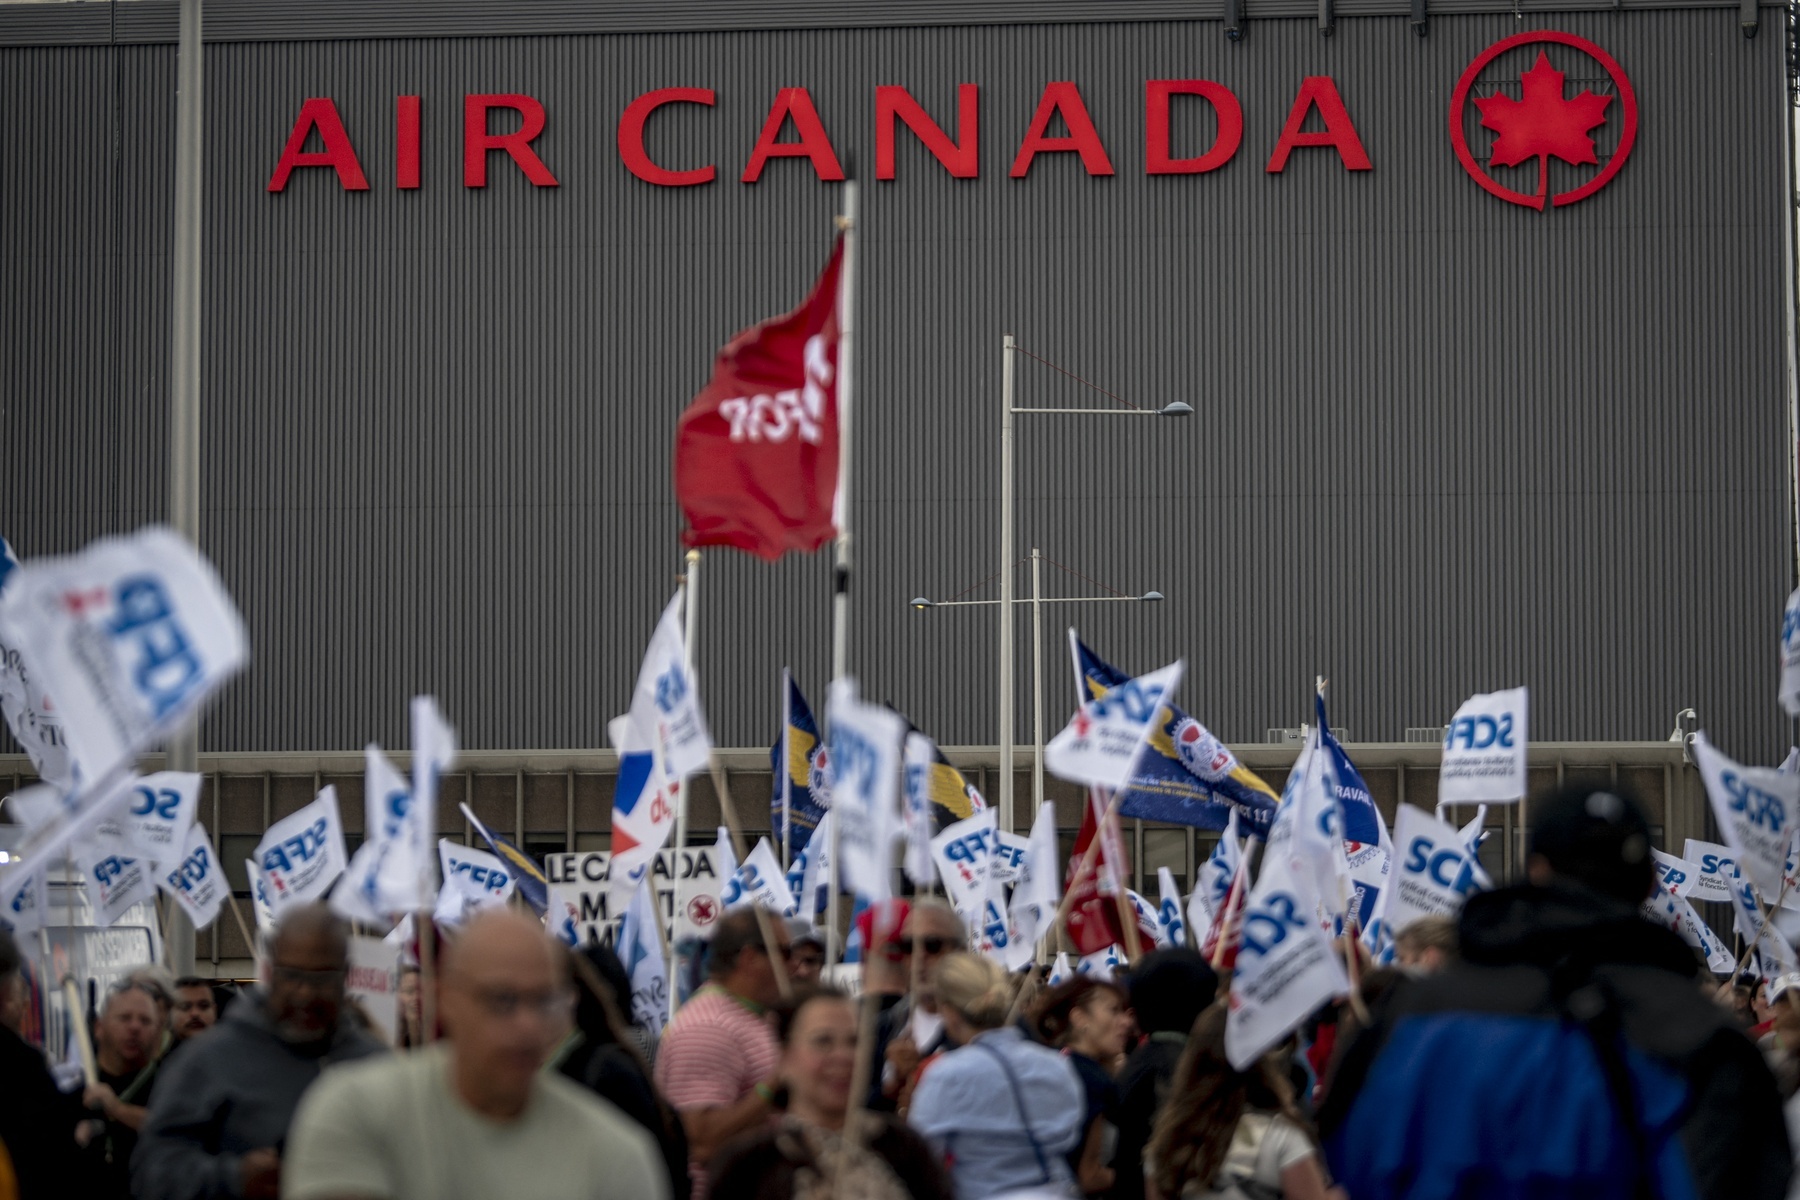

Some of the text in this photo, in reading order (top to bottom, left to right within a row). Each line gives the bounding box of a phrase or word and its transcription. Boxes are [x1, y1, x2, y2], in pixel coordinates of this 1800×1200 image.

[268, 76, 1372, 191] AIR CANADA
[1334, 785, 1372, 807] RAVAIL
[1253, 808, 1269, 824] 11
[548, 850, 716, 883] LE CADA
[1699, 874, 1723, 887] Syndicat
[1704, 882, 1729, 892] fonction
